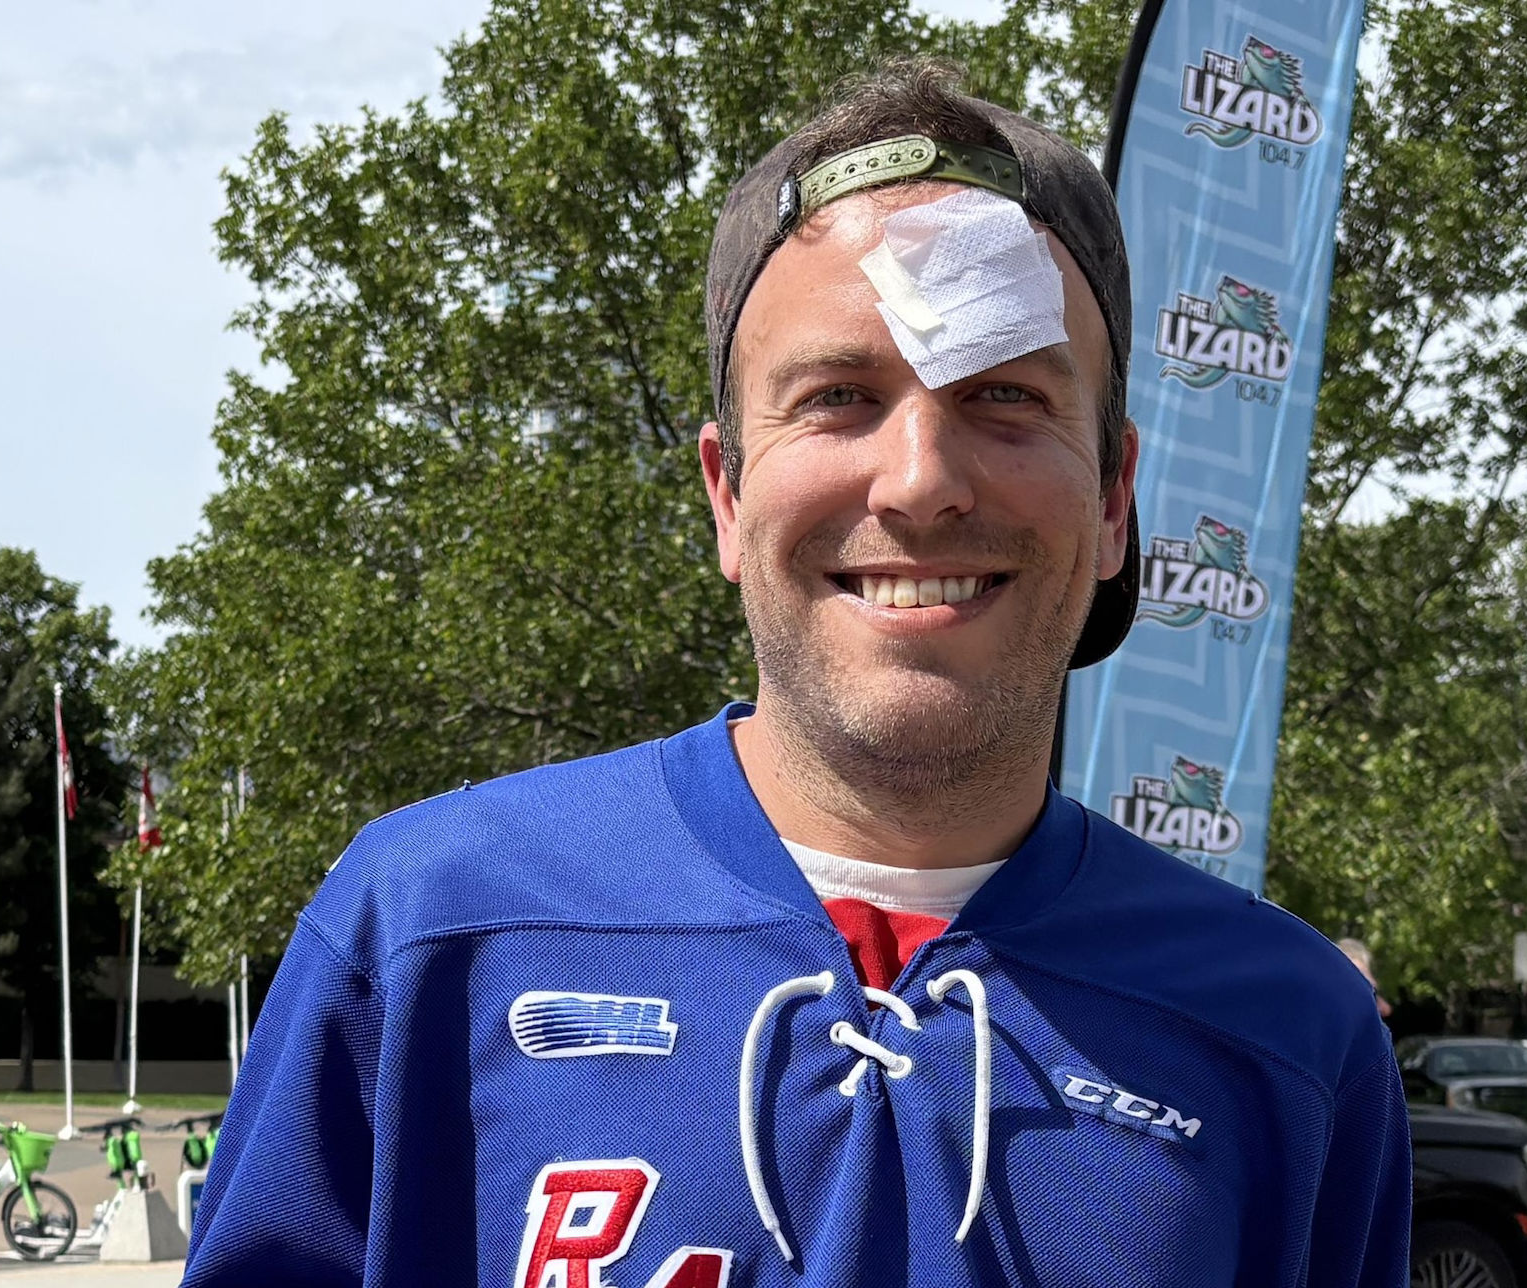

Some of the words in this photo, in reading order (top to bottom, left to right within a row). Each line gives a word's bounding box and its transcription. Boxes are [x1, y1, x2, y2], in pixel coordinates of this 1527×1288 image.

[1206, 53, 1236, 80] THE
[1184, 67, 1319, 142] LIZARD
[1180, 297, 1211, 322] THE
[1159, 311, 1290, 381] LIZARD
[1154, 539, 1188, 561] THE
[1136, 778, 1166, 801] THE
[1063, 1074, 1203, 1139] CCM
